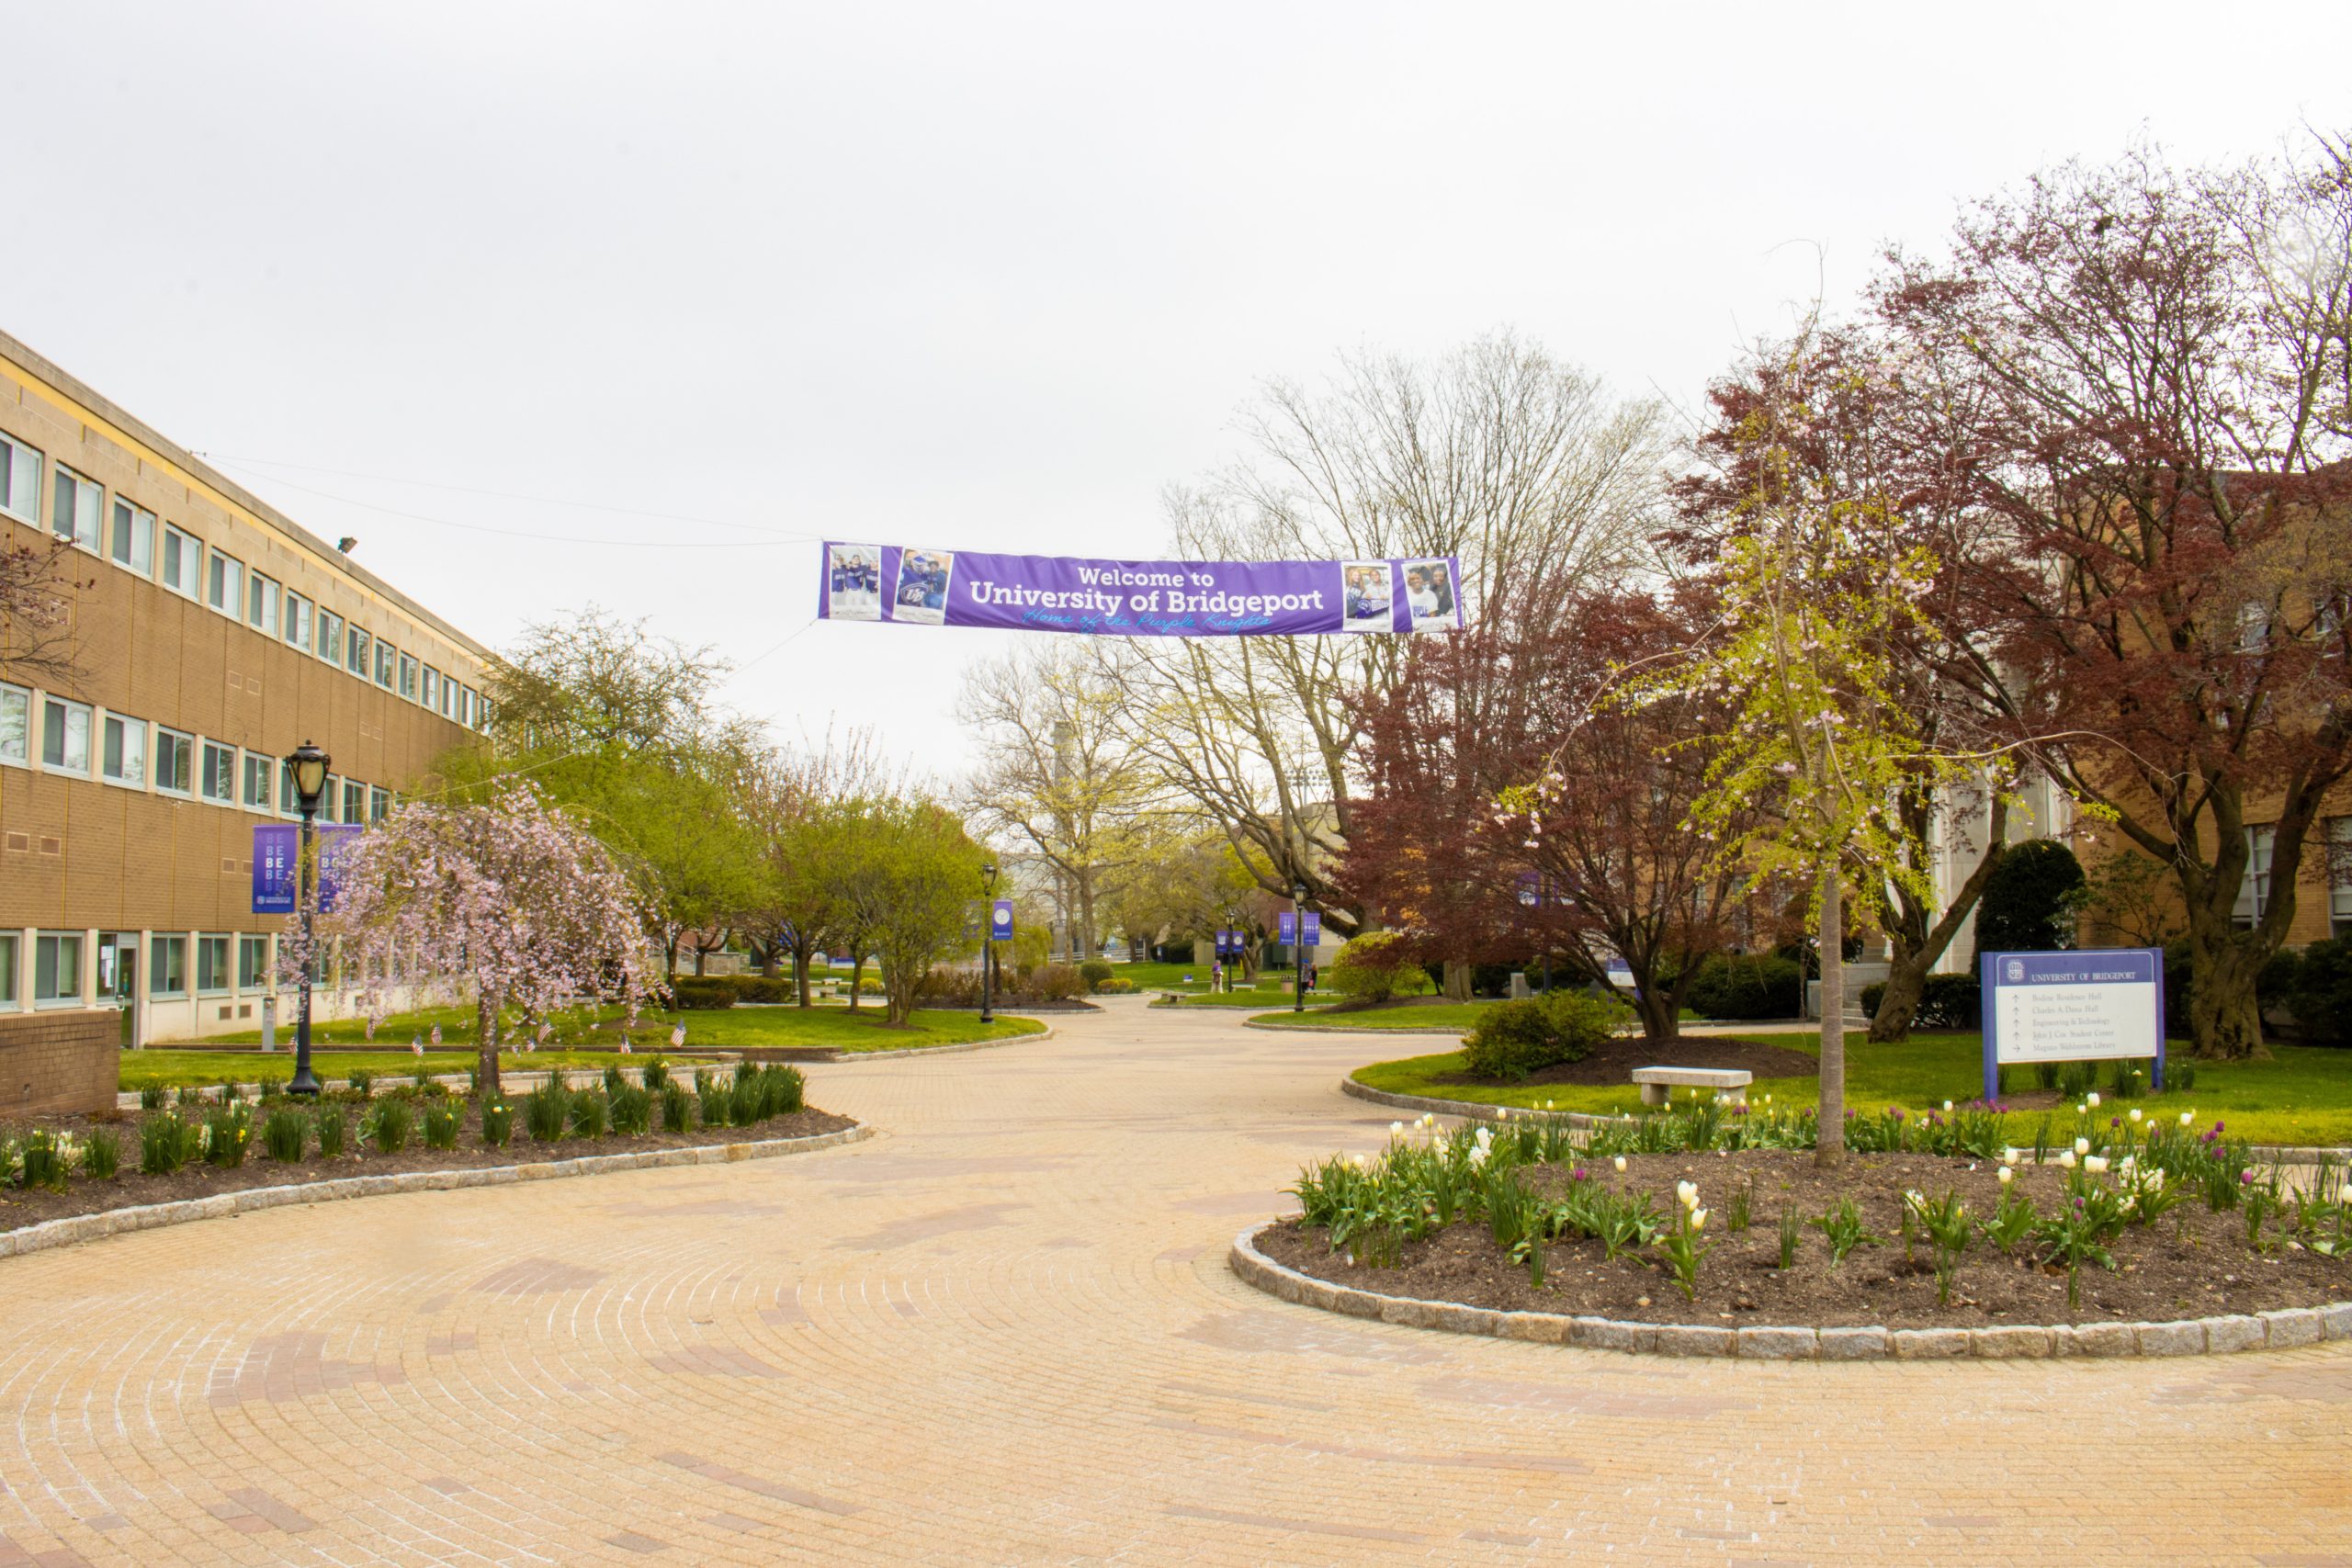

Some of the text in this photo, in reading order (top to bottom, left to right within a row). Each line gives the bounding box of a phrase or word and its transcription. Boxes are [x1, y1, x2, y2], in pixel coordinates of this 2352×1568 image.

[1078, 567, 1215, 587] Welcome to
[970, 581, 1323, 617] University of Bridgeport
[1023, 608, 1272, 634] Home of the Purple Knights
[266, 833, 284, 844] BE
[266, 845, 284, 856] BE
[266, 857, 284, 868] BE
[266, 869, 284, 880] BE
[2031, 973, 2075, 982] UNIVERSITY
[2092, 972, 2136, 980] BRIDGEPORT
[2032, 1019, 2069, 1027] Engineering
[2077, 1017, 2109, 1025] Technology
[2069, 1029, 2092, 1037] Student
[2094, 1042, 2116, 1050] Library
